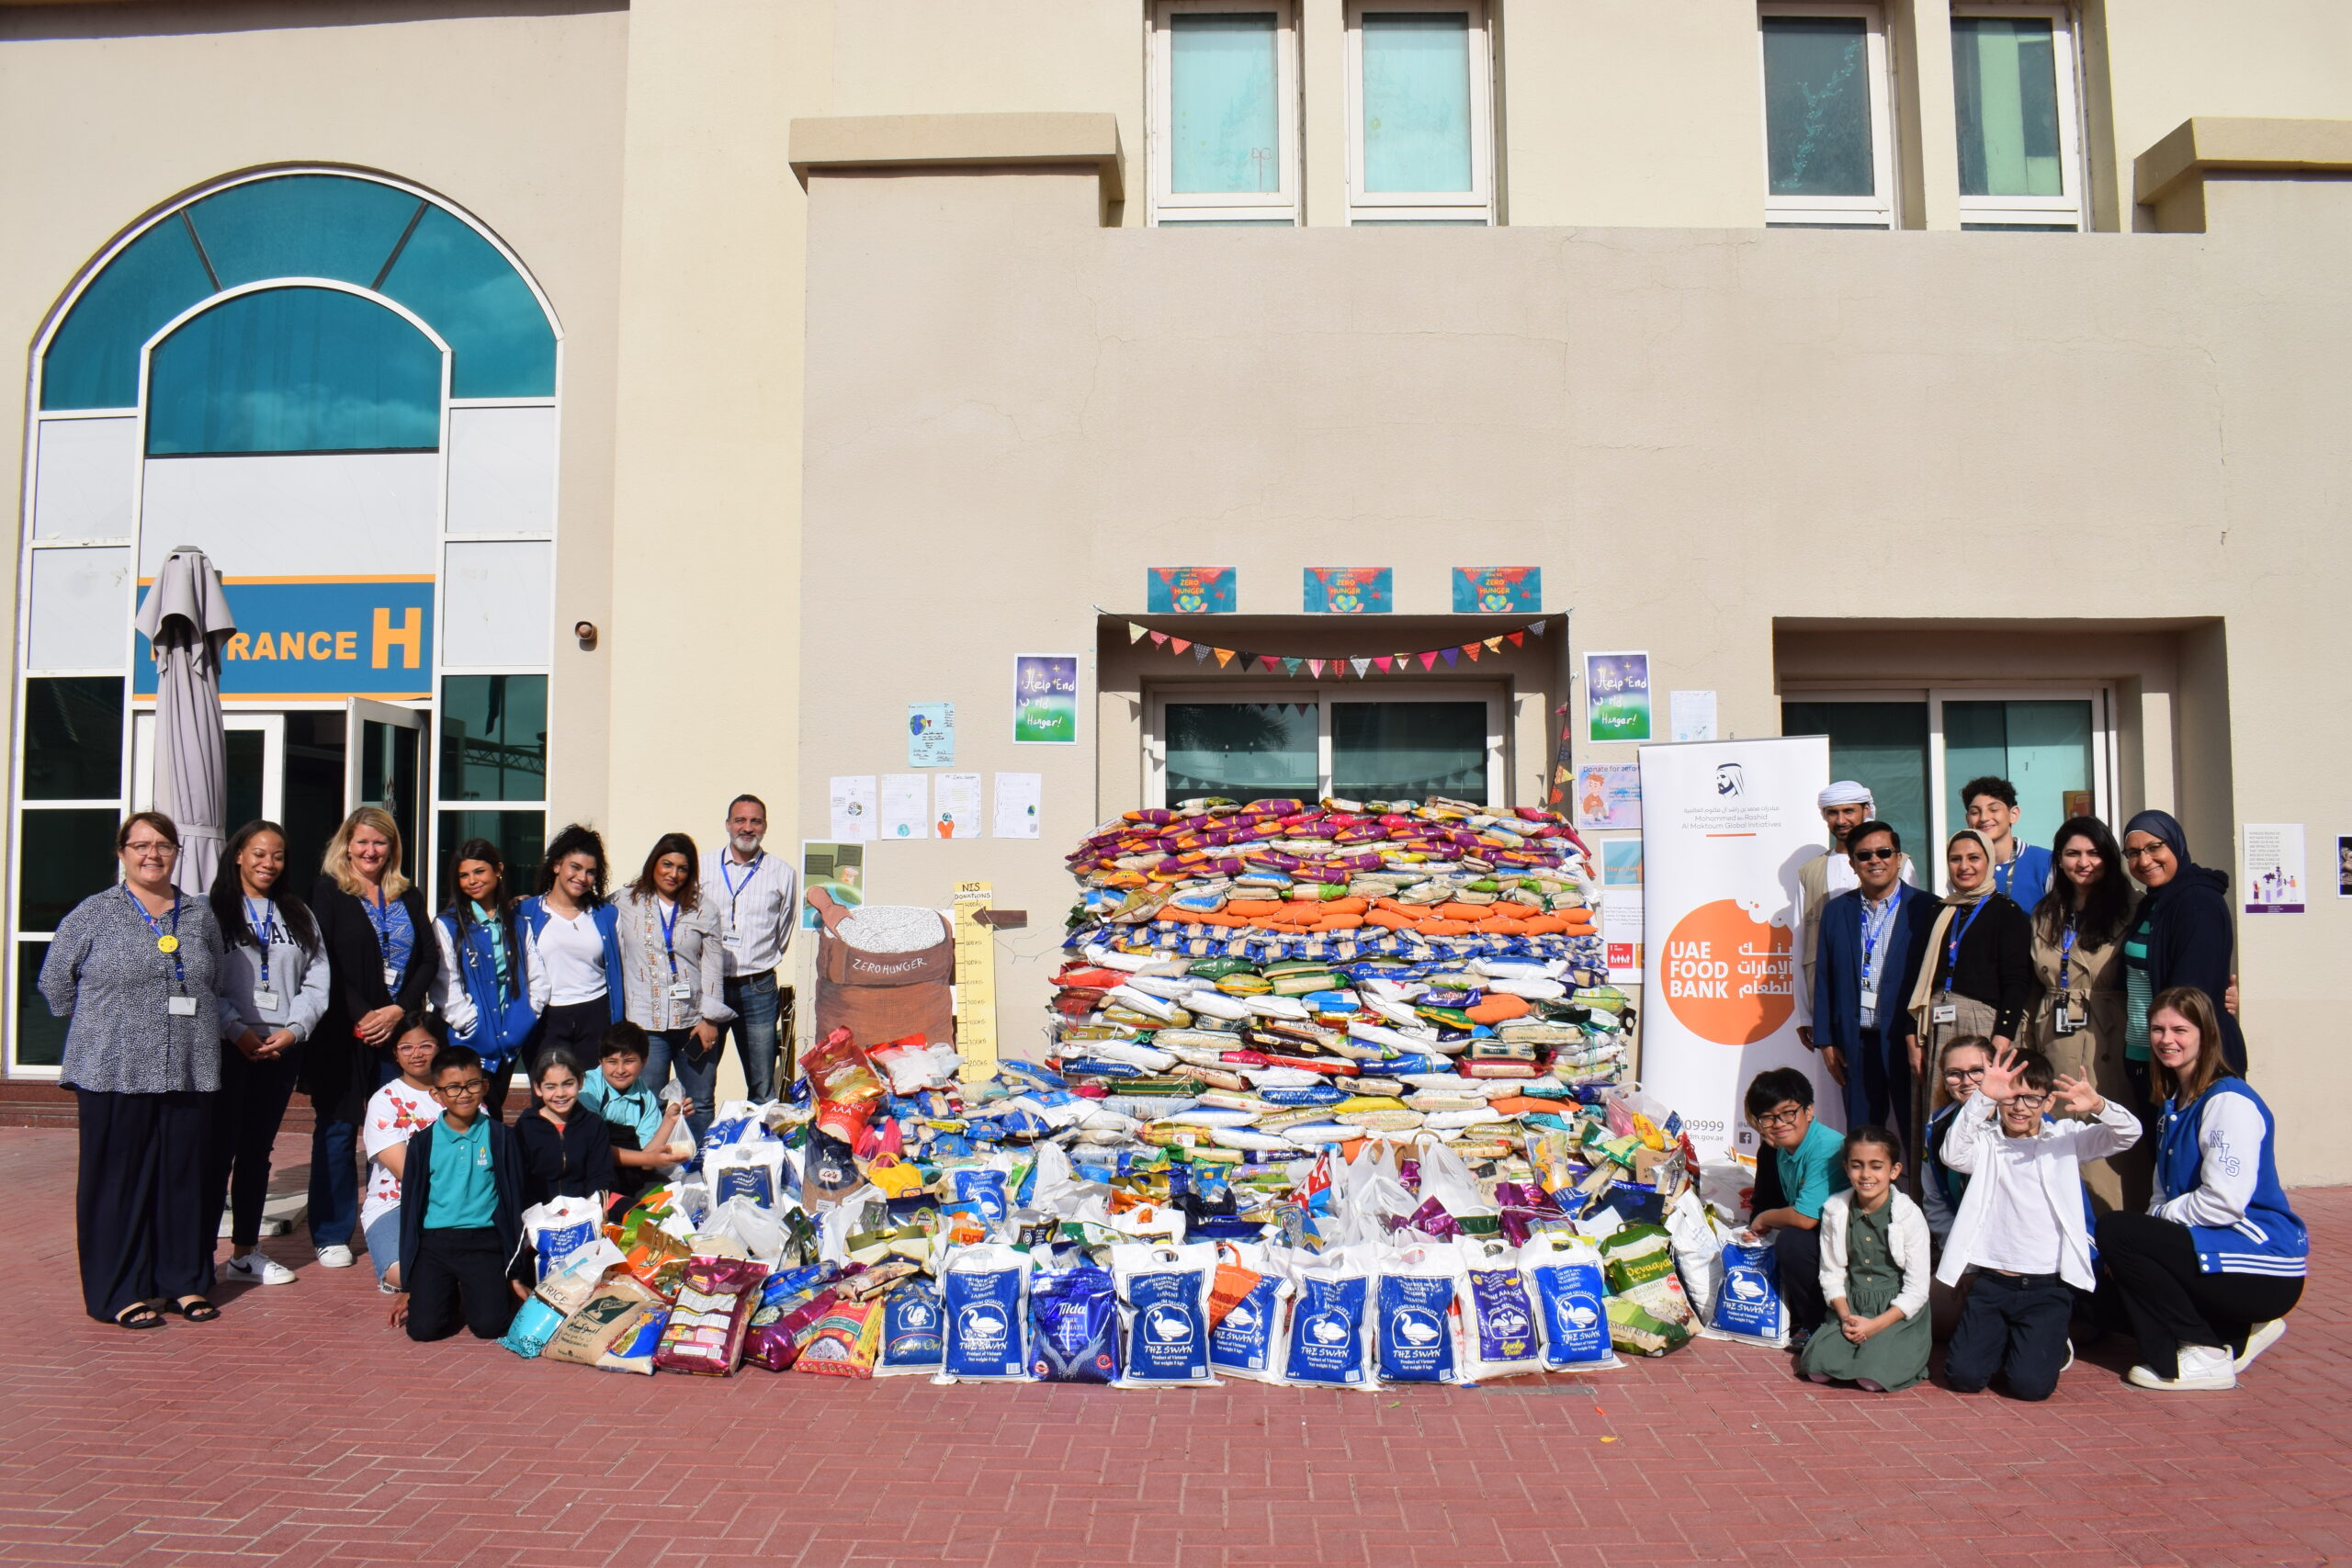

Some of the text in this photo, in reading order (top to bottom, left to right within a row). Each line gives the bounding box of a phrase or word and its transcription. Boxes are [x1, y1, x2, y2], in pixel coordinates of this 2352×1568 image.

[371, 607, 422, 669] H
[1023, 666, 1075, 693] Help End
[1596, 668, 1646, 690] Help End
[1027, 714, 1063, 728] Hunger!
[1601, 713, 1637, 728] Hunger!
[962, 883, 980, 892] NIS
[1669, 941, 1712, 959] UAE
[853, 957, 927, 975] ZERO HUNGER
[1669, 960, 1792, 979] FOOD الإمارات
[1669, 980, 1792, 999] BANK للطعام
[1345, 1081, 1360, 1089] Afrah
[831, 1106, 853, 1115] AAA
[1682, 1120, 1724, 1132] 09999
[2210, 1130, 2240, 1177] NIS
[546, 1286, 571, 1304] RICE
[1573, 1290, 1596, 1299] QUALITY
[984, 1299, 1006, 1308] QUALITY
[1057, 1303, 1086, 1315] Tilda
[1393, 1304, 1438, 1315] PREMIUM QUALITY
[1723, 1301, 1765, 1314] THE SWAN
[1562, 1330, 1600, 1342] THE SWAN
[1610, 1323, 1651, 1338] SMATI RICE
[1226, 1332, 1255, 1343] SWAN
[979, 1341, 1008, 1350] SWAN
[1145, 1345, 1194, 1354] THE SWAN
[1501, 1339, 1525, 1350] Lucky
[1301, 1347, 1350, 1358] THE SWAN
[1393, 1348, 1441, 1359] THE SWAN
